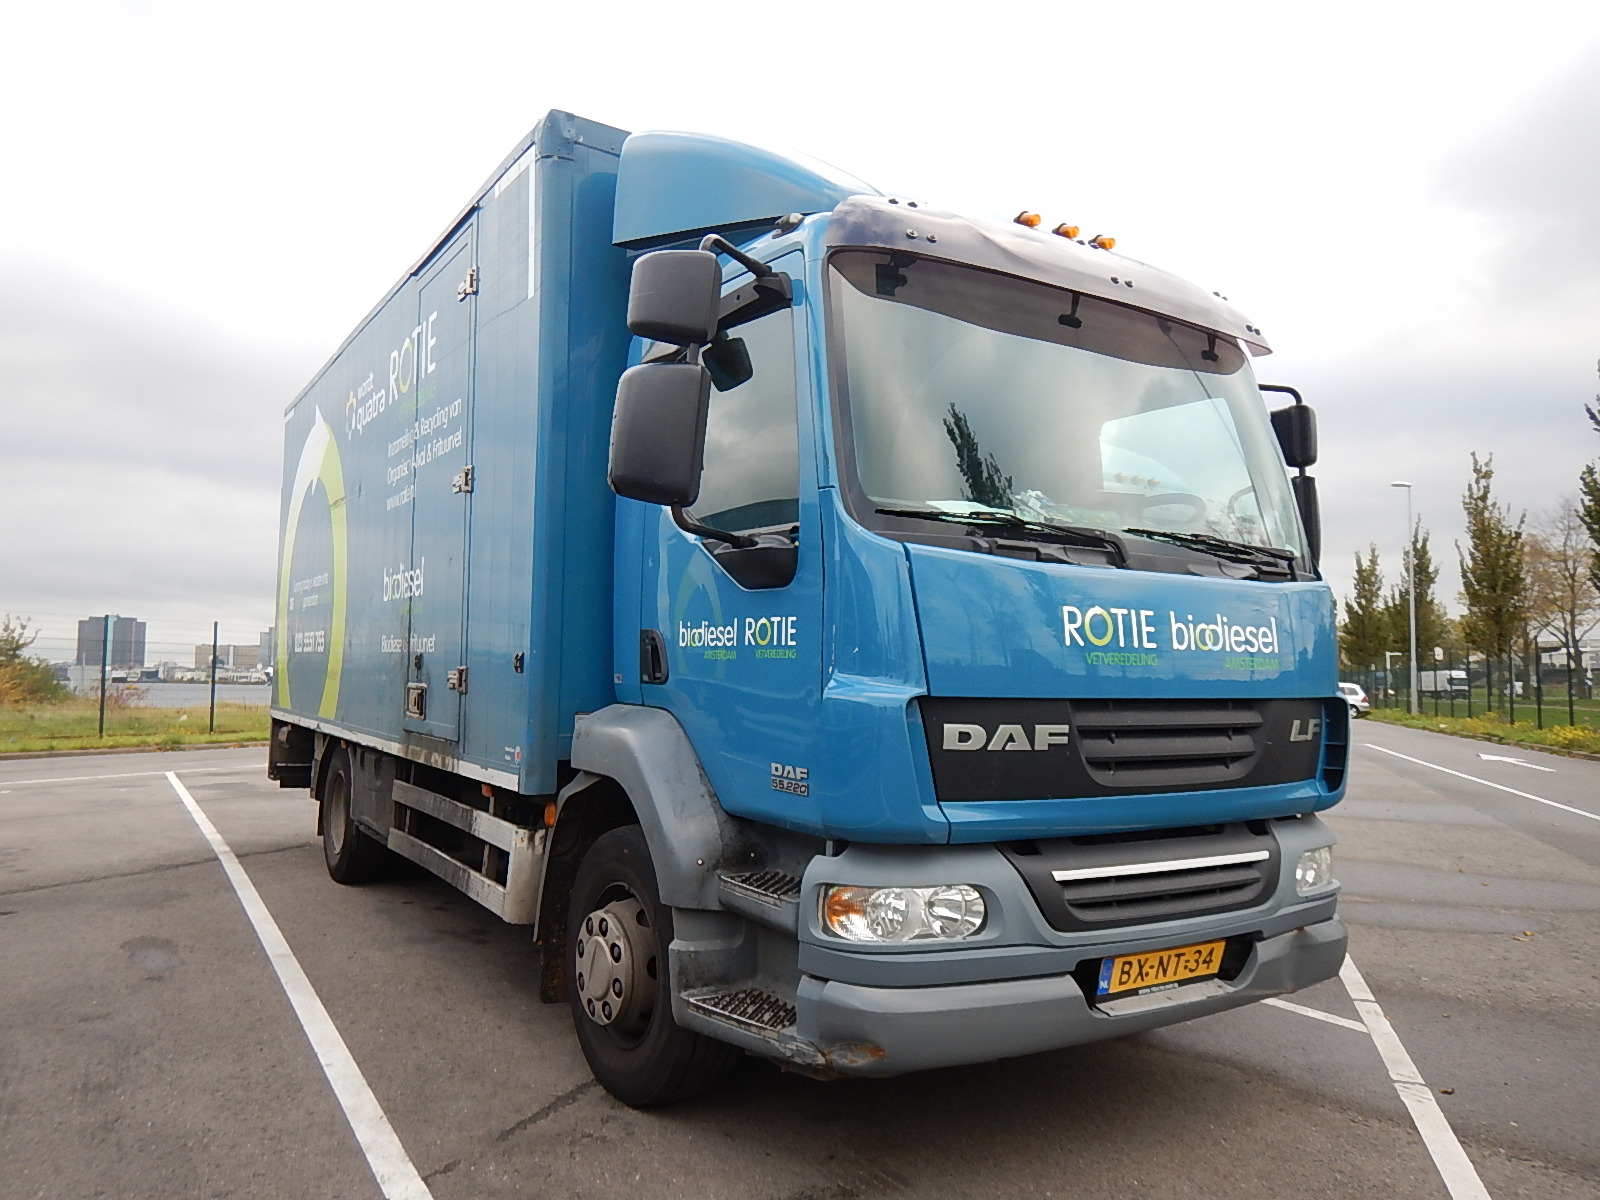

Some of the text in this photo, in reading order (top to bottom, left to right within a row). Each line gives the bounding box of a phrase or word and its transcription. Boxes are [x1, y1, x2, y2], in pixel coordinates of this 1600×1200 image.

[389, 310, 438, 405] ROTIE
[356, 388, 385, 436] quatra
[421, 407, 449, 436] Recycling
[383, 556, 425, 602] biodiesel
[679, 616, 797, 647] biodiesel ROTIE
[1062, 605, 1279, 654] ROTIE biodiesel
[381, 633, 402, 653] Biodiese
[704, 650, 737, 660] AMSTERDAM
[1085, 652, 1158, 666] VETVEREDELING
[1225, 657, 1279, 671] AMSTERDAM
[942, 723, 1070, 751] DAF
[1289, 718, 1321, 742] LF
[770, 762, 809, 779] DAF
[771, 777, 809, 795] 55.220
[1118, 947, 1215, 986] BX-NT-34
[1099, 980, 1109, 989] NL
